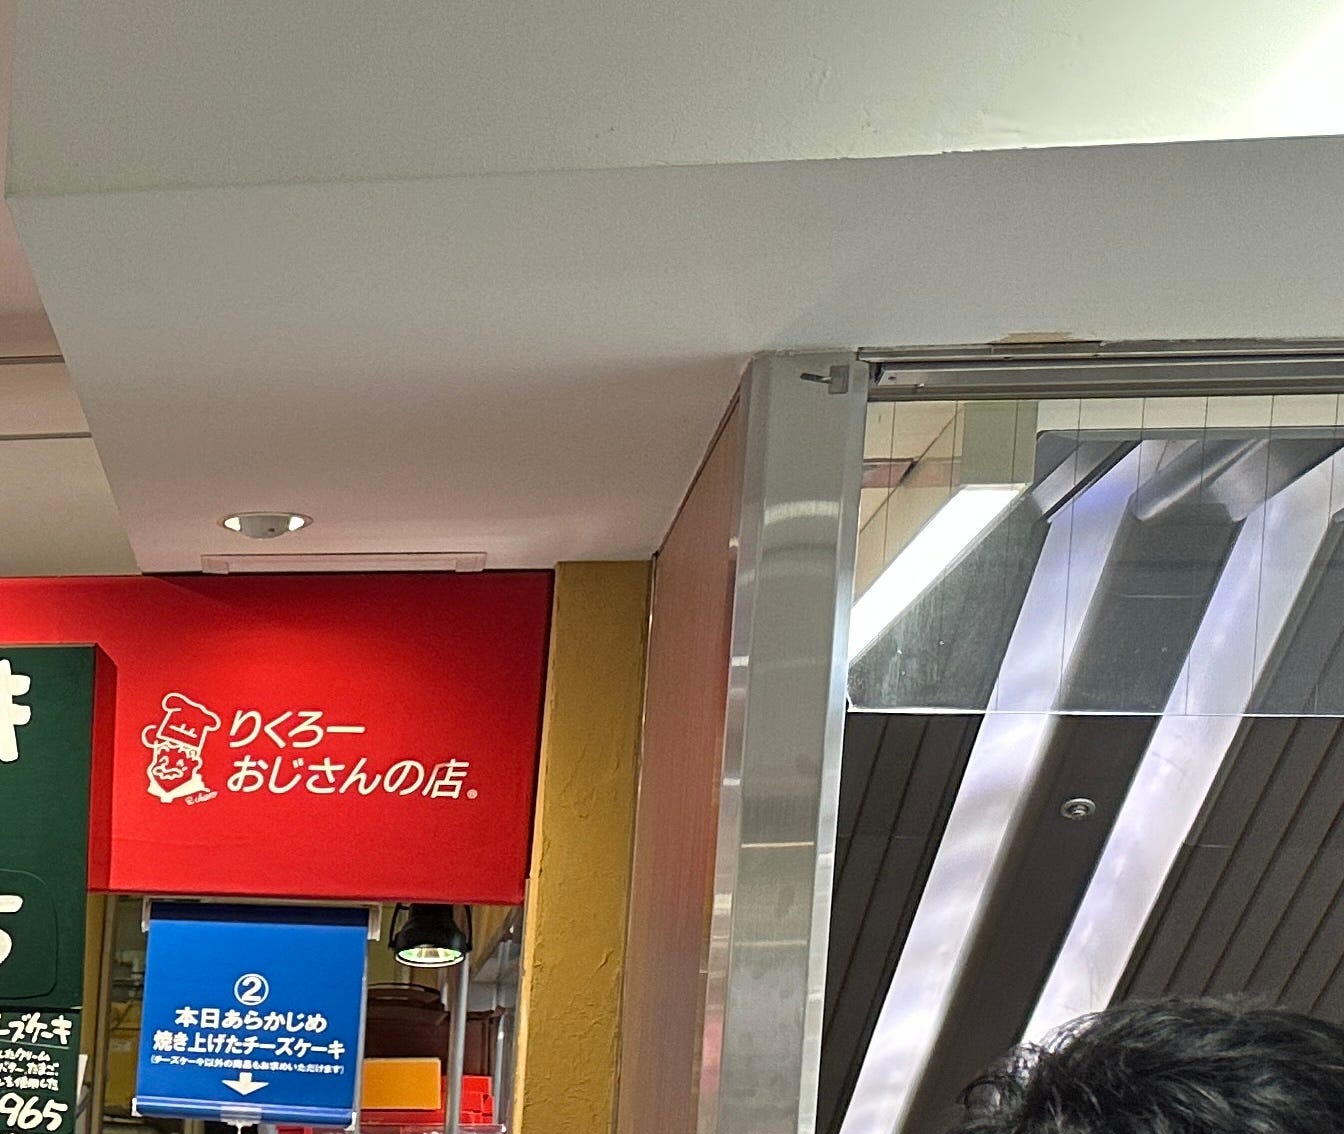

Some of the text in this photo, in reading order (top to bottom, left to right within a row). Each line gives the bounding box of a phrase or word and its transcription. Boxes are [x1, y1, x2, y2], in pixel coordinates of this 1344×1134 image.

[229, 710, 365, 749] りくろー
[174, 1006, 328, 1034] 本日あらかじめ
[152, 1029, 346, 1060] 焼き上げたチーズケーキ
